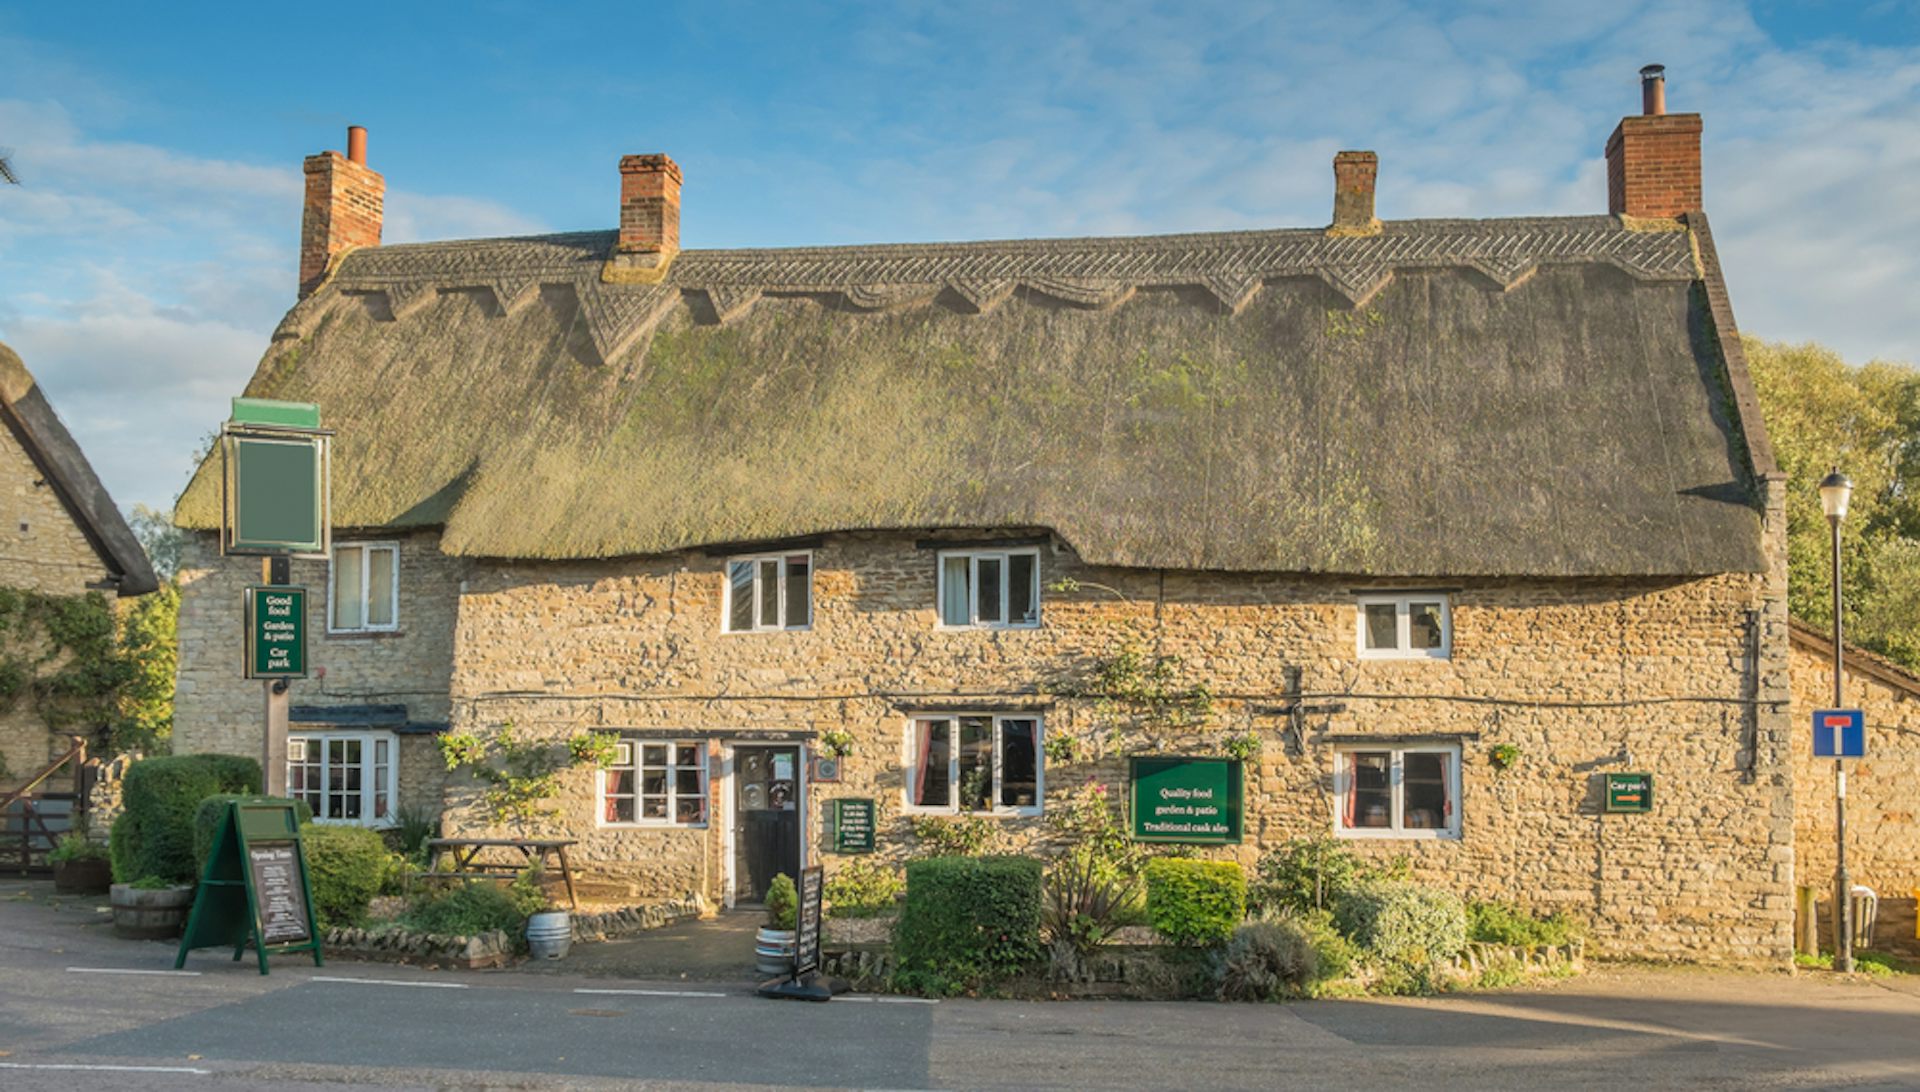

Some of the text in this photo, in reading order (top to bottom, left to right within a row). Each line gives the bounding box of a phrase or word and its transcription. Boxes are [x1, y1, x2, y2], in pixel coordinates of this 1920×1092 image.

[266, 595, 292, 605] Good
[268, 606, 290, 616] food
[263, 621, 295, 630] Garden
[263, 632, 295, 642] & patio
[269, 647, 288, 657] Car
[268, 658, 290, 669] park
[1611, 780, 1646, 792] Car park
[1160, 788, 1213, 799] Quality food
[1155, 805, 1218, 816] garden & patio
[1144, 822, 1229, 832] Traditional cask ales
